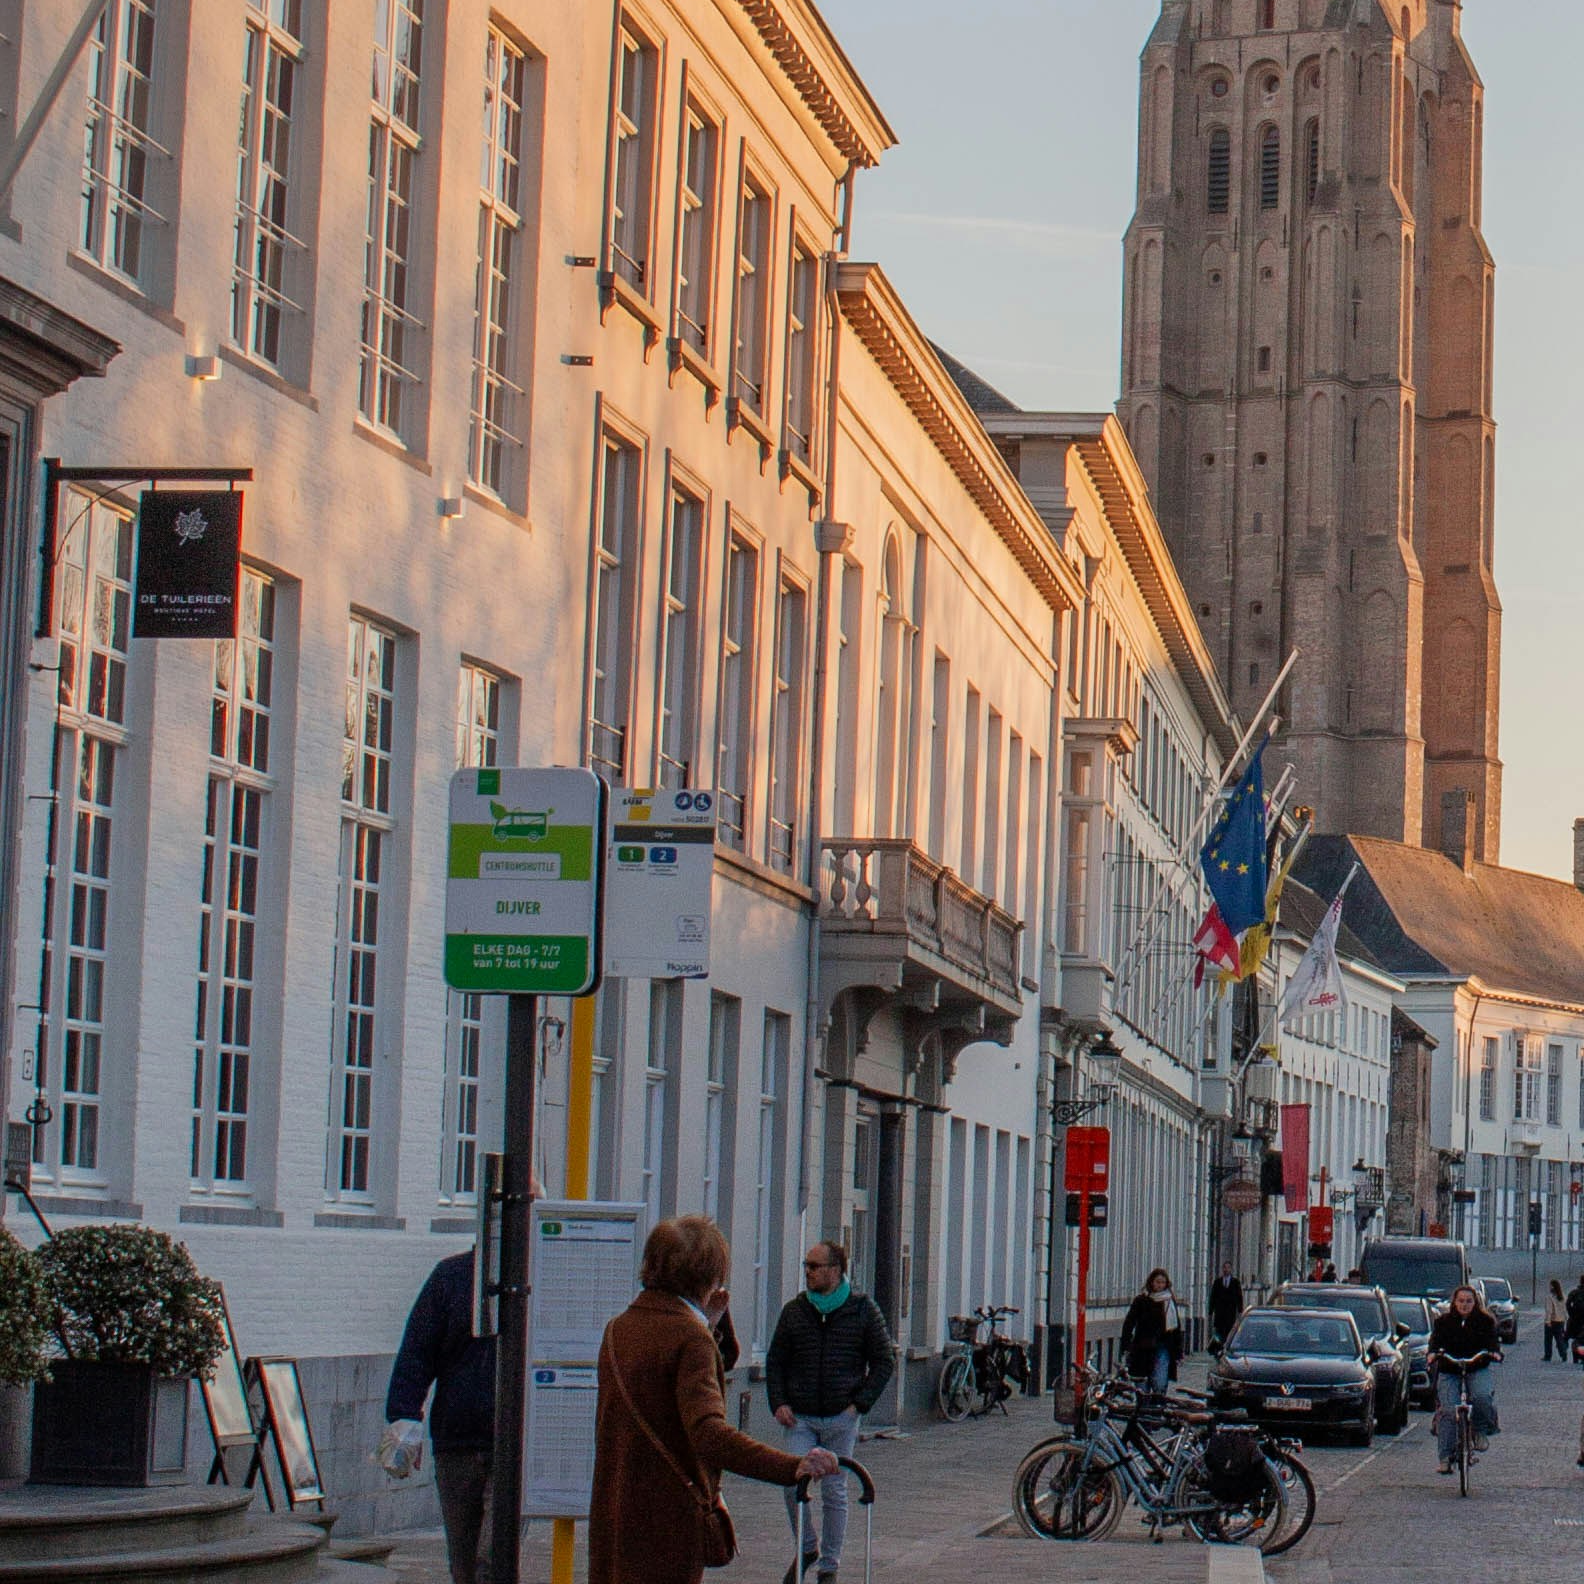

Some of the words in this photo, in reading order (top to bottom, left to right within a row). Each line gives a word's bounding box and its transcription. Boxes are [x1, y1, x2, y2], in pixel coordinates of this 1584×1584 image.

[141, 594, 157, 604] DE
[629, 849, 635, 860] 1
[659, 850, 667, 861] 2
[496, 900, 541, 914] DIJVER
[473, 944, 504, 956] ELKE
[507, 944, 531, 956] DAG
[473, 959, 493, 968] van
[505, 957, 520, 968] tot
[524, 958, 537, 968] 19
[540, 959, 560, 969] uur
